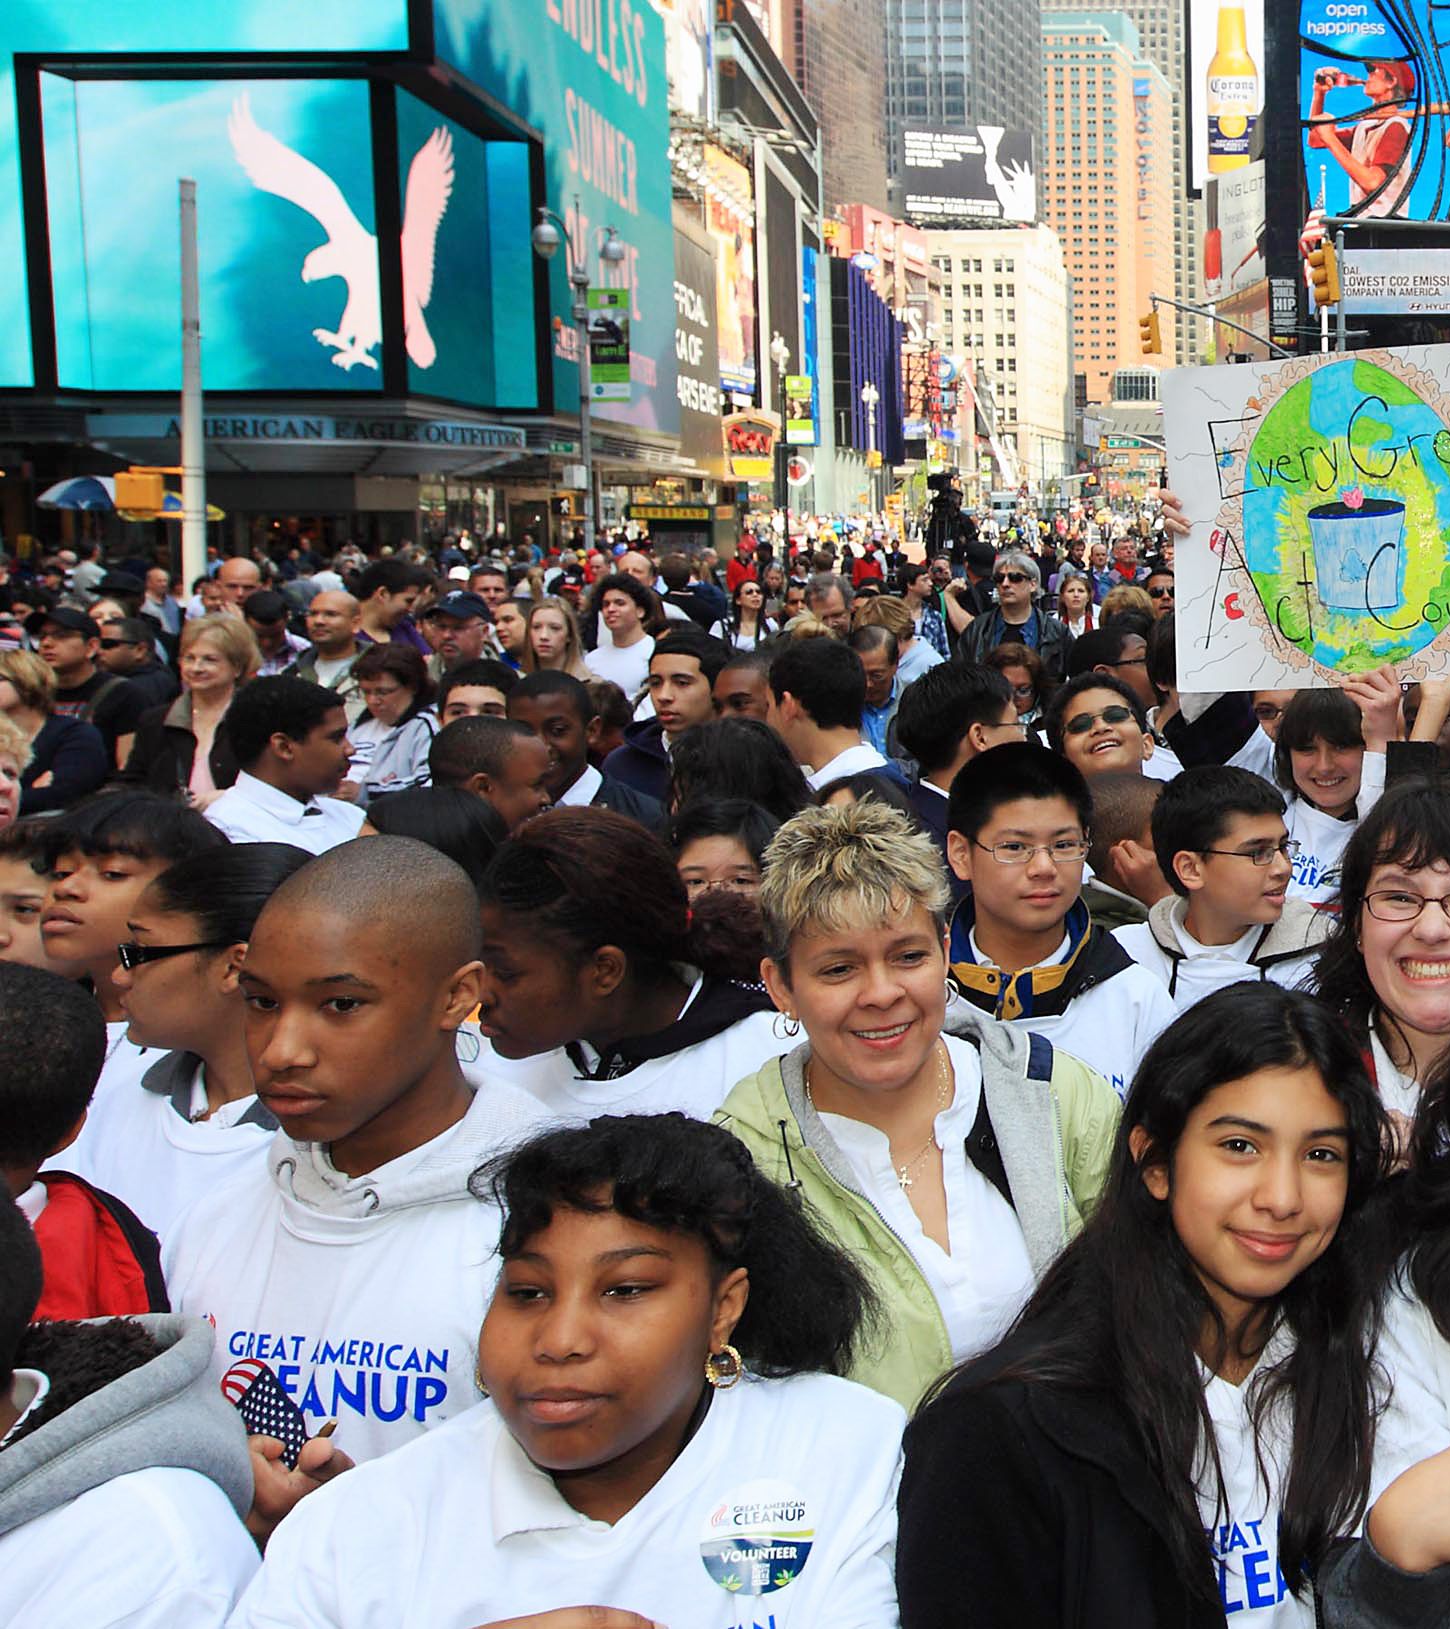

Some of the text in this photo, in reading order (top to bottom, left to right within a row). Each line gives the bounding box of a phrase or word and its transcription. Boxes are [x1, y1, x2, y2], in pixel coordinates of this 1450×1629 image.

[1326, 4, 1368, 18] open
[1307, 21, 1386, 36] happiness
[546, 0, 648, 108] DLESS
[1210, 78, 1255, 94] Corona
[565, 87, 638, 217] SUMMER
[1222, 176, 1265, 200] INGLOT
[1343, 276, 1385, 288] LOWEST
[1387, 288, 1396, 297] IN
[1398, 287, 1443, 298] AMERICA.
[165, 417, 523, 447] AERICAN EAGLE OUTFITTERS
[1207, 414, 1339, 500] Every
[1205, 529, 1315, 651] Act
[228, 1330, 449, 1374] GREAT AMERICAN
[276, 1364, 448, 1423] EANUP
[733, 1500, 806, 1513] GREAT AMERICAN
[733, 1508, 806, 1526] CLEANUP
[720, 1546, 798, 1564] VOLUNTEER
